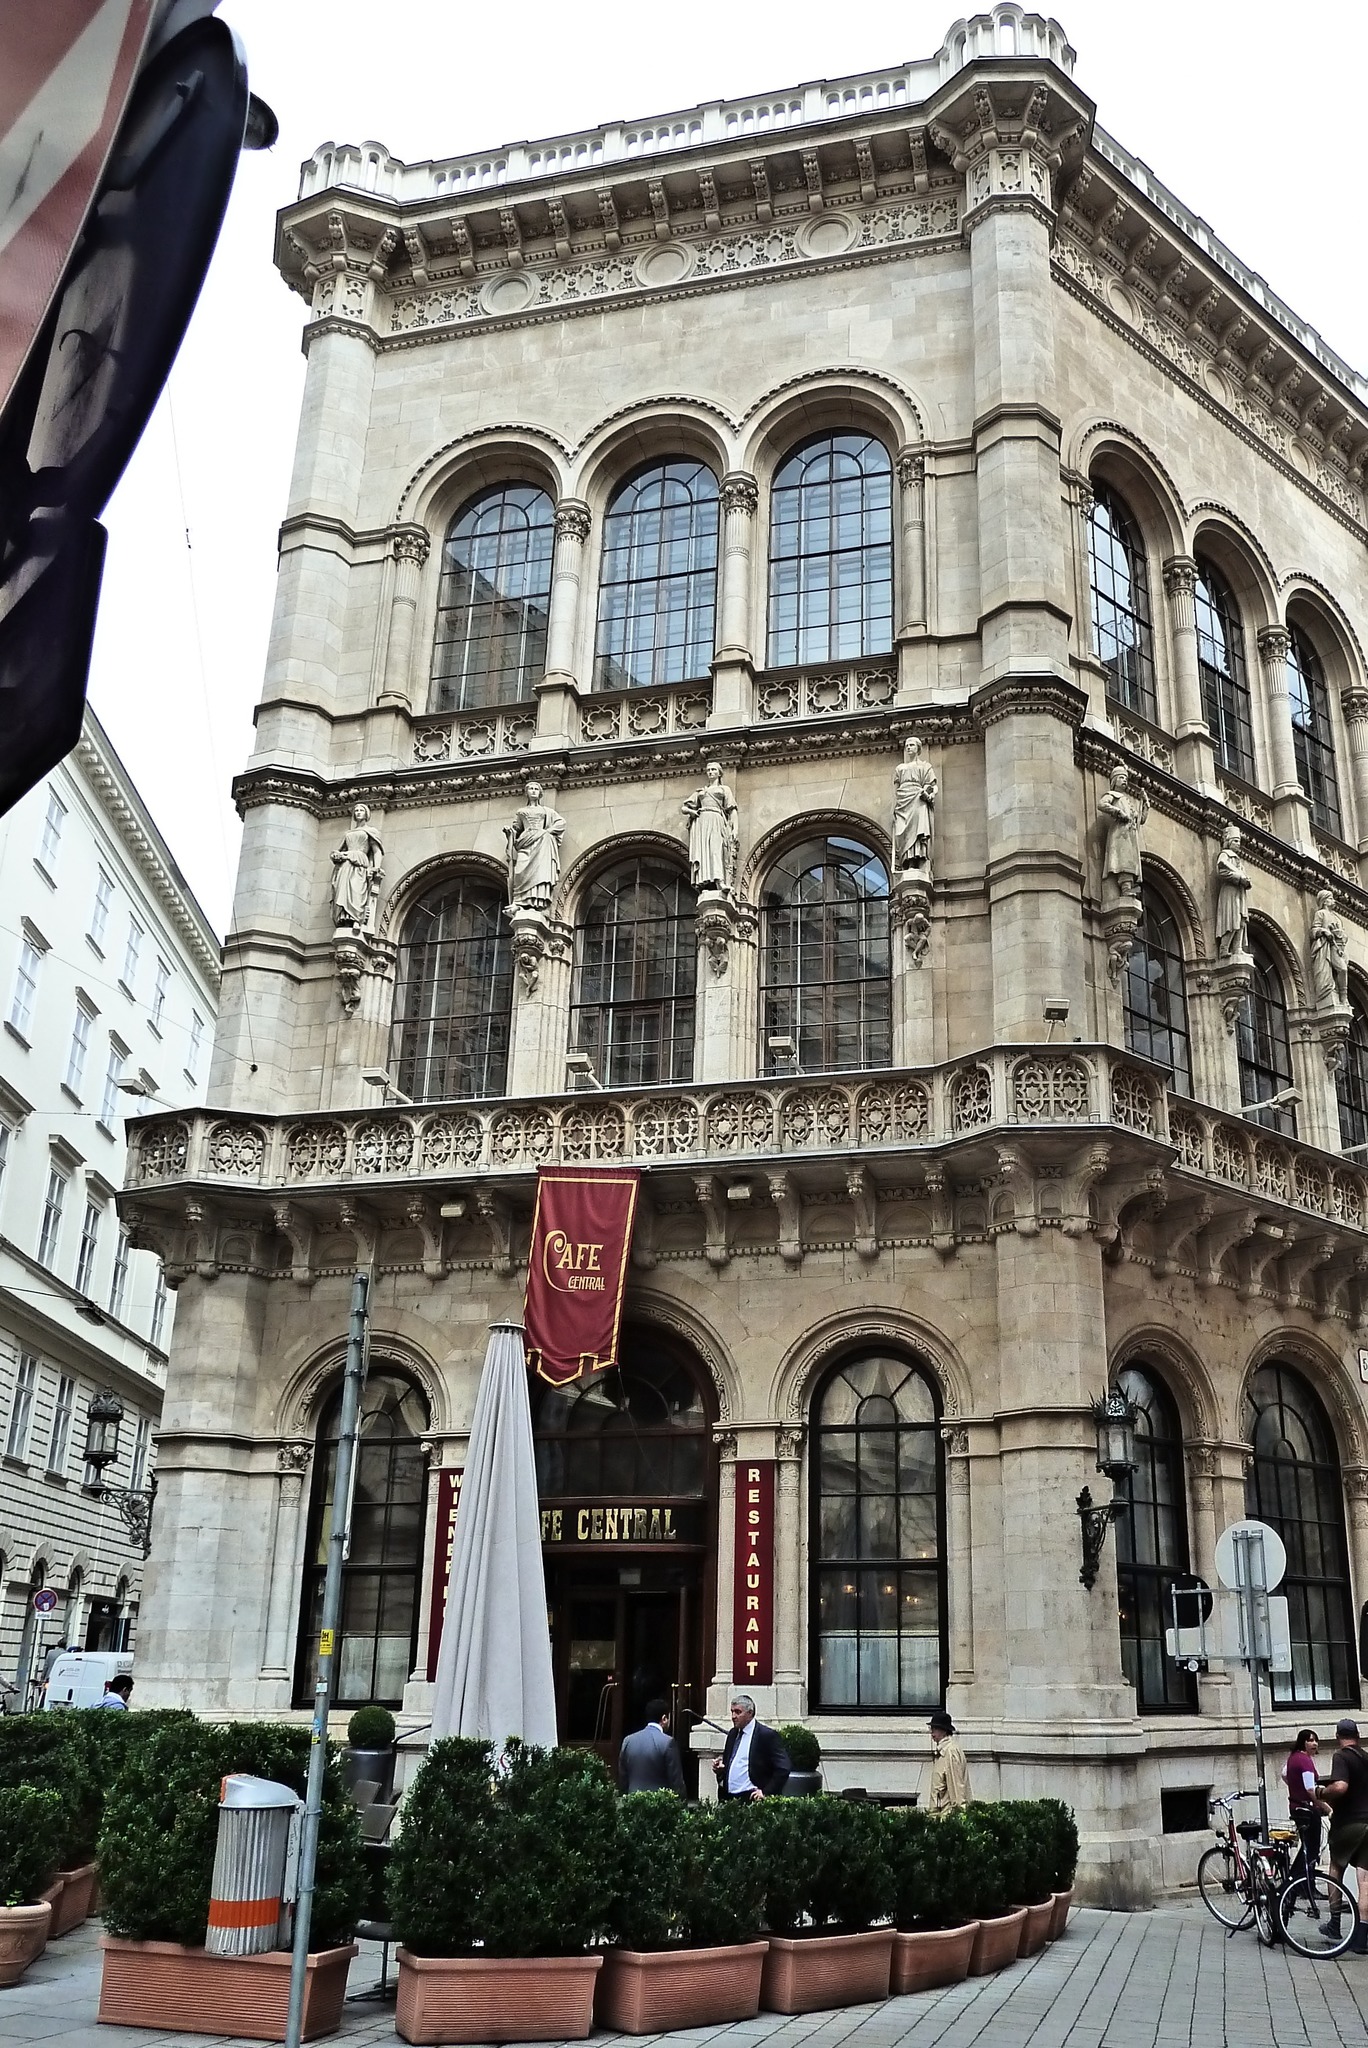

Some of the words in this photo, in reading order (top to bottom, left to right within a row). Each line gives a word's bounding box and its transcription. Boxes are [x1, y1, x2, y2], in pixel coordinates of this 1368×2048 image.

[543, 1230, 604, 1292] CAFE
[568, 1275, 606, 1291] CENTRAL
[541, 1509, 563, 1541] FE
[577, 1508, 677, 1540] CENTRAL
[746, 1468, 761, 1676] RESTAURANT
